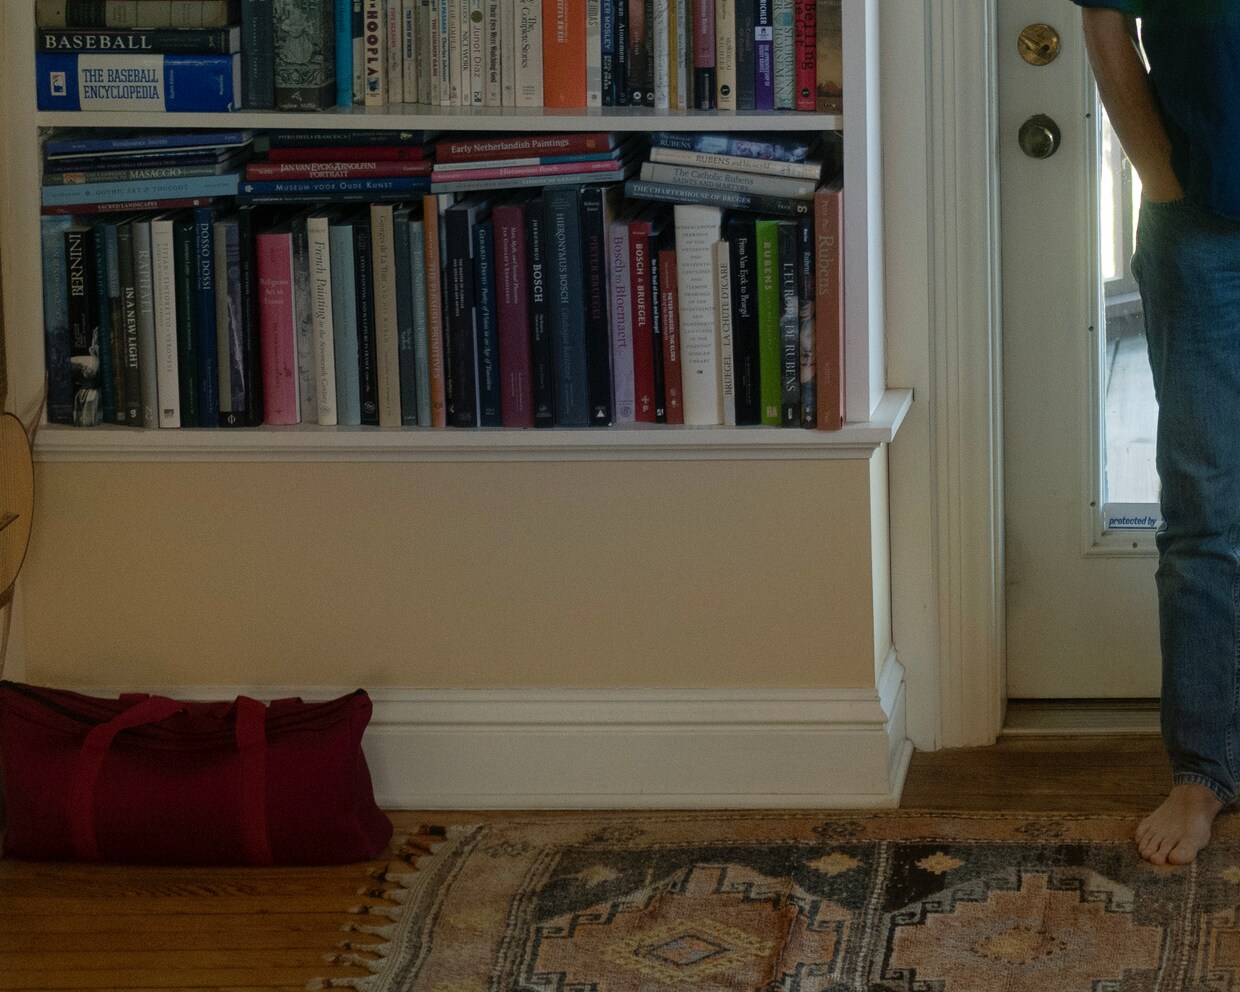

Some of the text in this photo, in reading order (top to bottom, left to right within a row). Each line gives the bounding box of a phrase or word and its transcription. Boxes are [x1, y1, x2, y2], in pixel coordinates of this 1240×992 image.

[45, 35, 152, 49] BASEBALL
[366, 10, 378, 76] HOOPLA
[473, 25, 482, 53] Junot
[520, 7, 530, 68] Complete Stories
[603, 16, 611, 50] MOSLEY
[82, 69, 158, 82] THE BASEBALL
[84, 85, 160, 99] ENCYCLOPEDIA
[451, 139, 569, 154] Early Netherlandish Paintings
[129, 169, 181, 179] MASACCIO
[555, 213, 569, 303] HIERONYMUS BOSCH
[613, 236, 625, 273] Bosch
[763, 242, 773, 290] RUBENS
[818, 236, 833, 295] Rubens
[126, 287, 134, 298] IN
[314, 242, 328, 319] French Painting
[533, 264, 543, 302] BOSCH
[635, 244, 646, 327] BOSCH BRUEGEL
[128, 310, 136, 335] NEW
[616, 286, 627, 349] Bloemaert
[783, 262, 796, 392] L'EUROPE DE RUBENS
[128, 337, 138, 369] LIGHT
[1109, 516, 1157, 526] protected by
